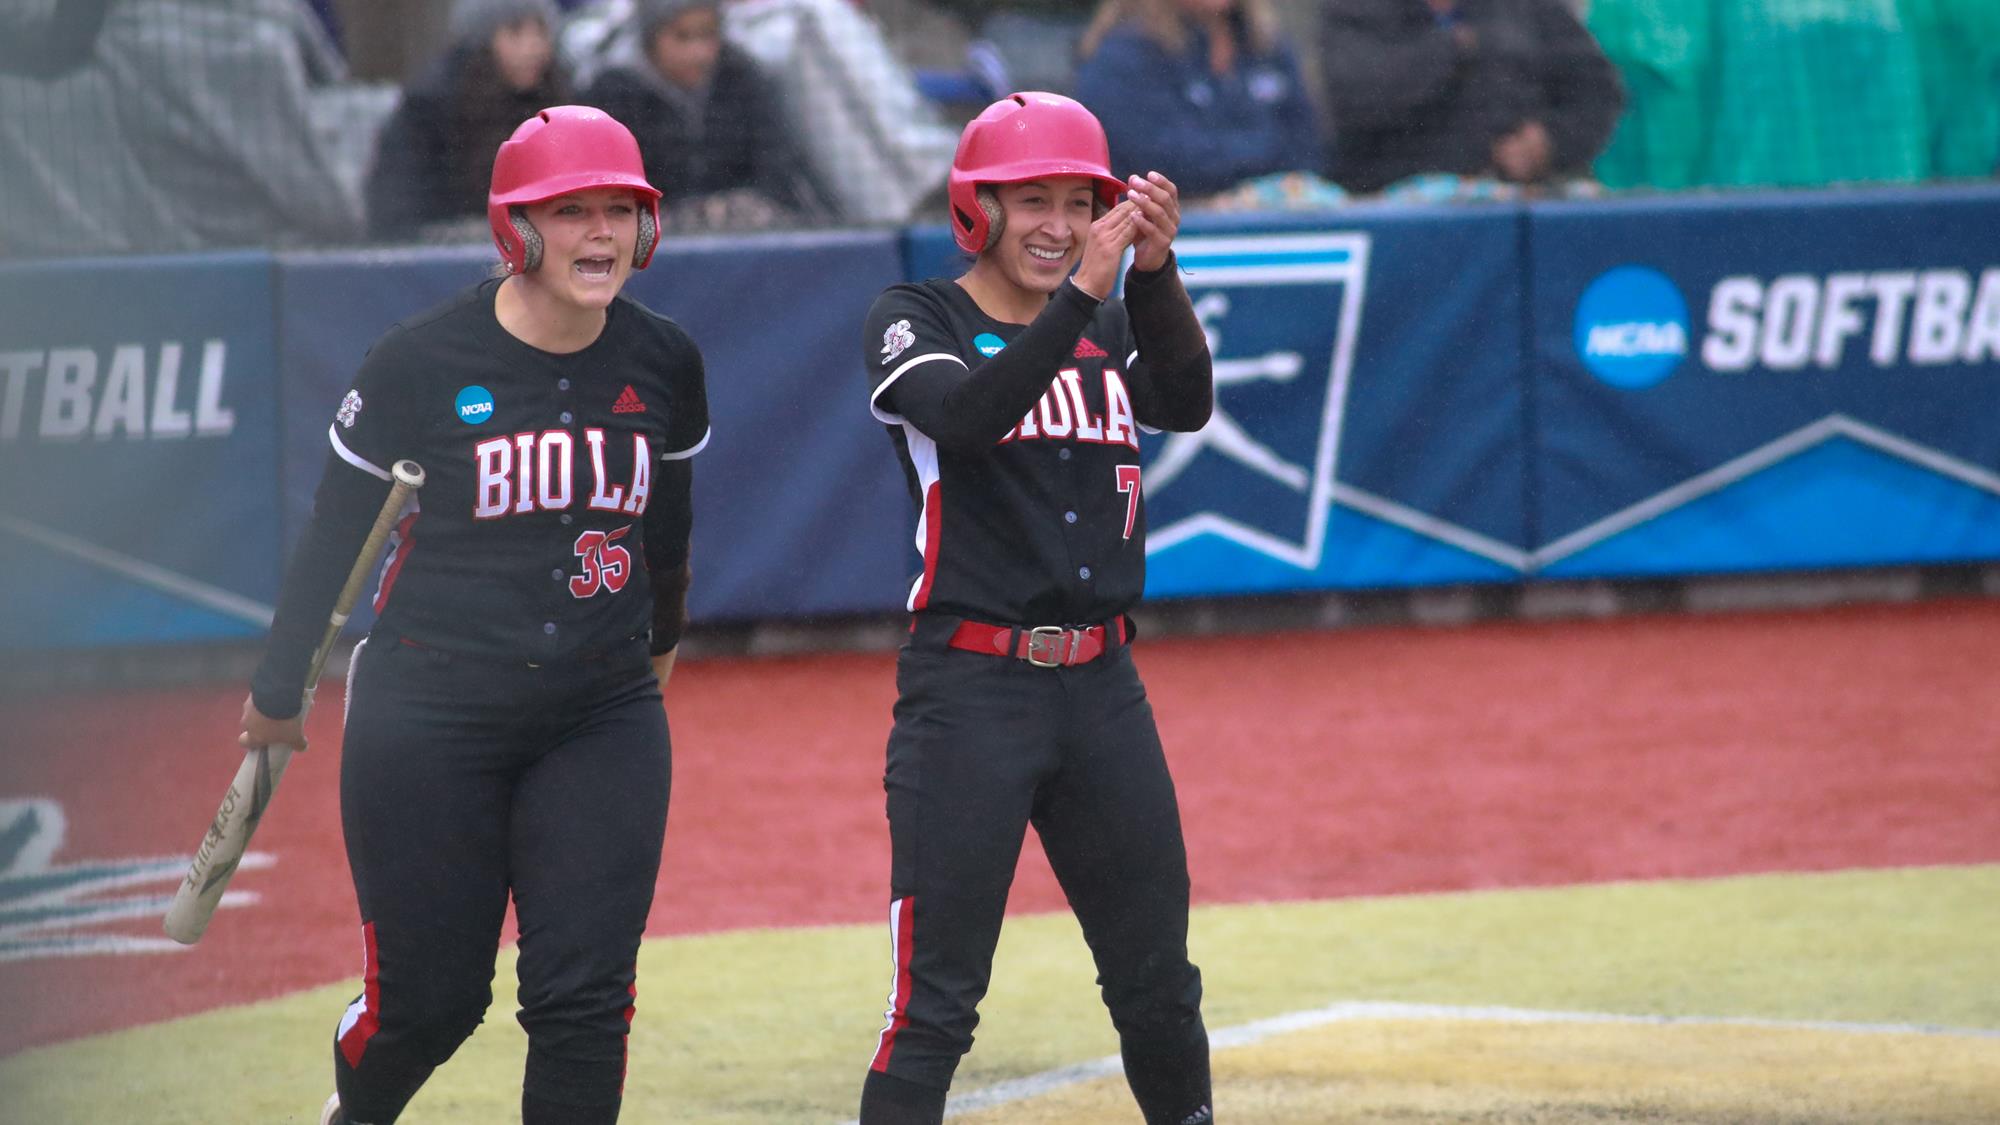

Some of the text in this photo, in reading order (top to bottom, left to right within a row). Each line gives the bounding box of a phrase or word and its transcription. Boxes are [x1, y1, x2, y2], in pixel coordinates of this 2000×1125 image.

[1586, 322, 1687, 356] NCAA
[1702, 268, 2000, 371] SOFTBA
[0, 339, 235, 439] TBALL
[461, 401, 492, 416] NCAA
[612, 402, 646, 414] adidas
[473, 427, 652, 519] BIOLA
[1115, 465, 1141, 540] 7
[569, 525, 631, 598] 35
